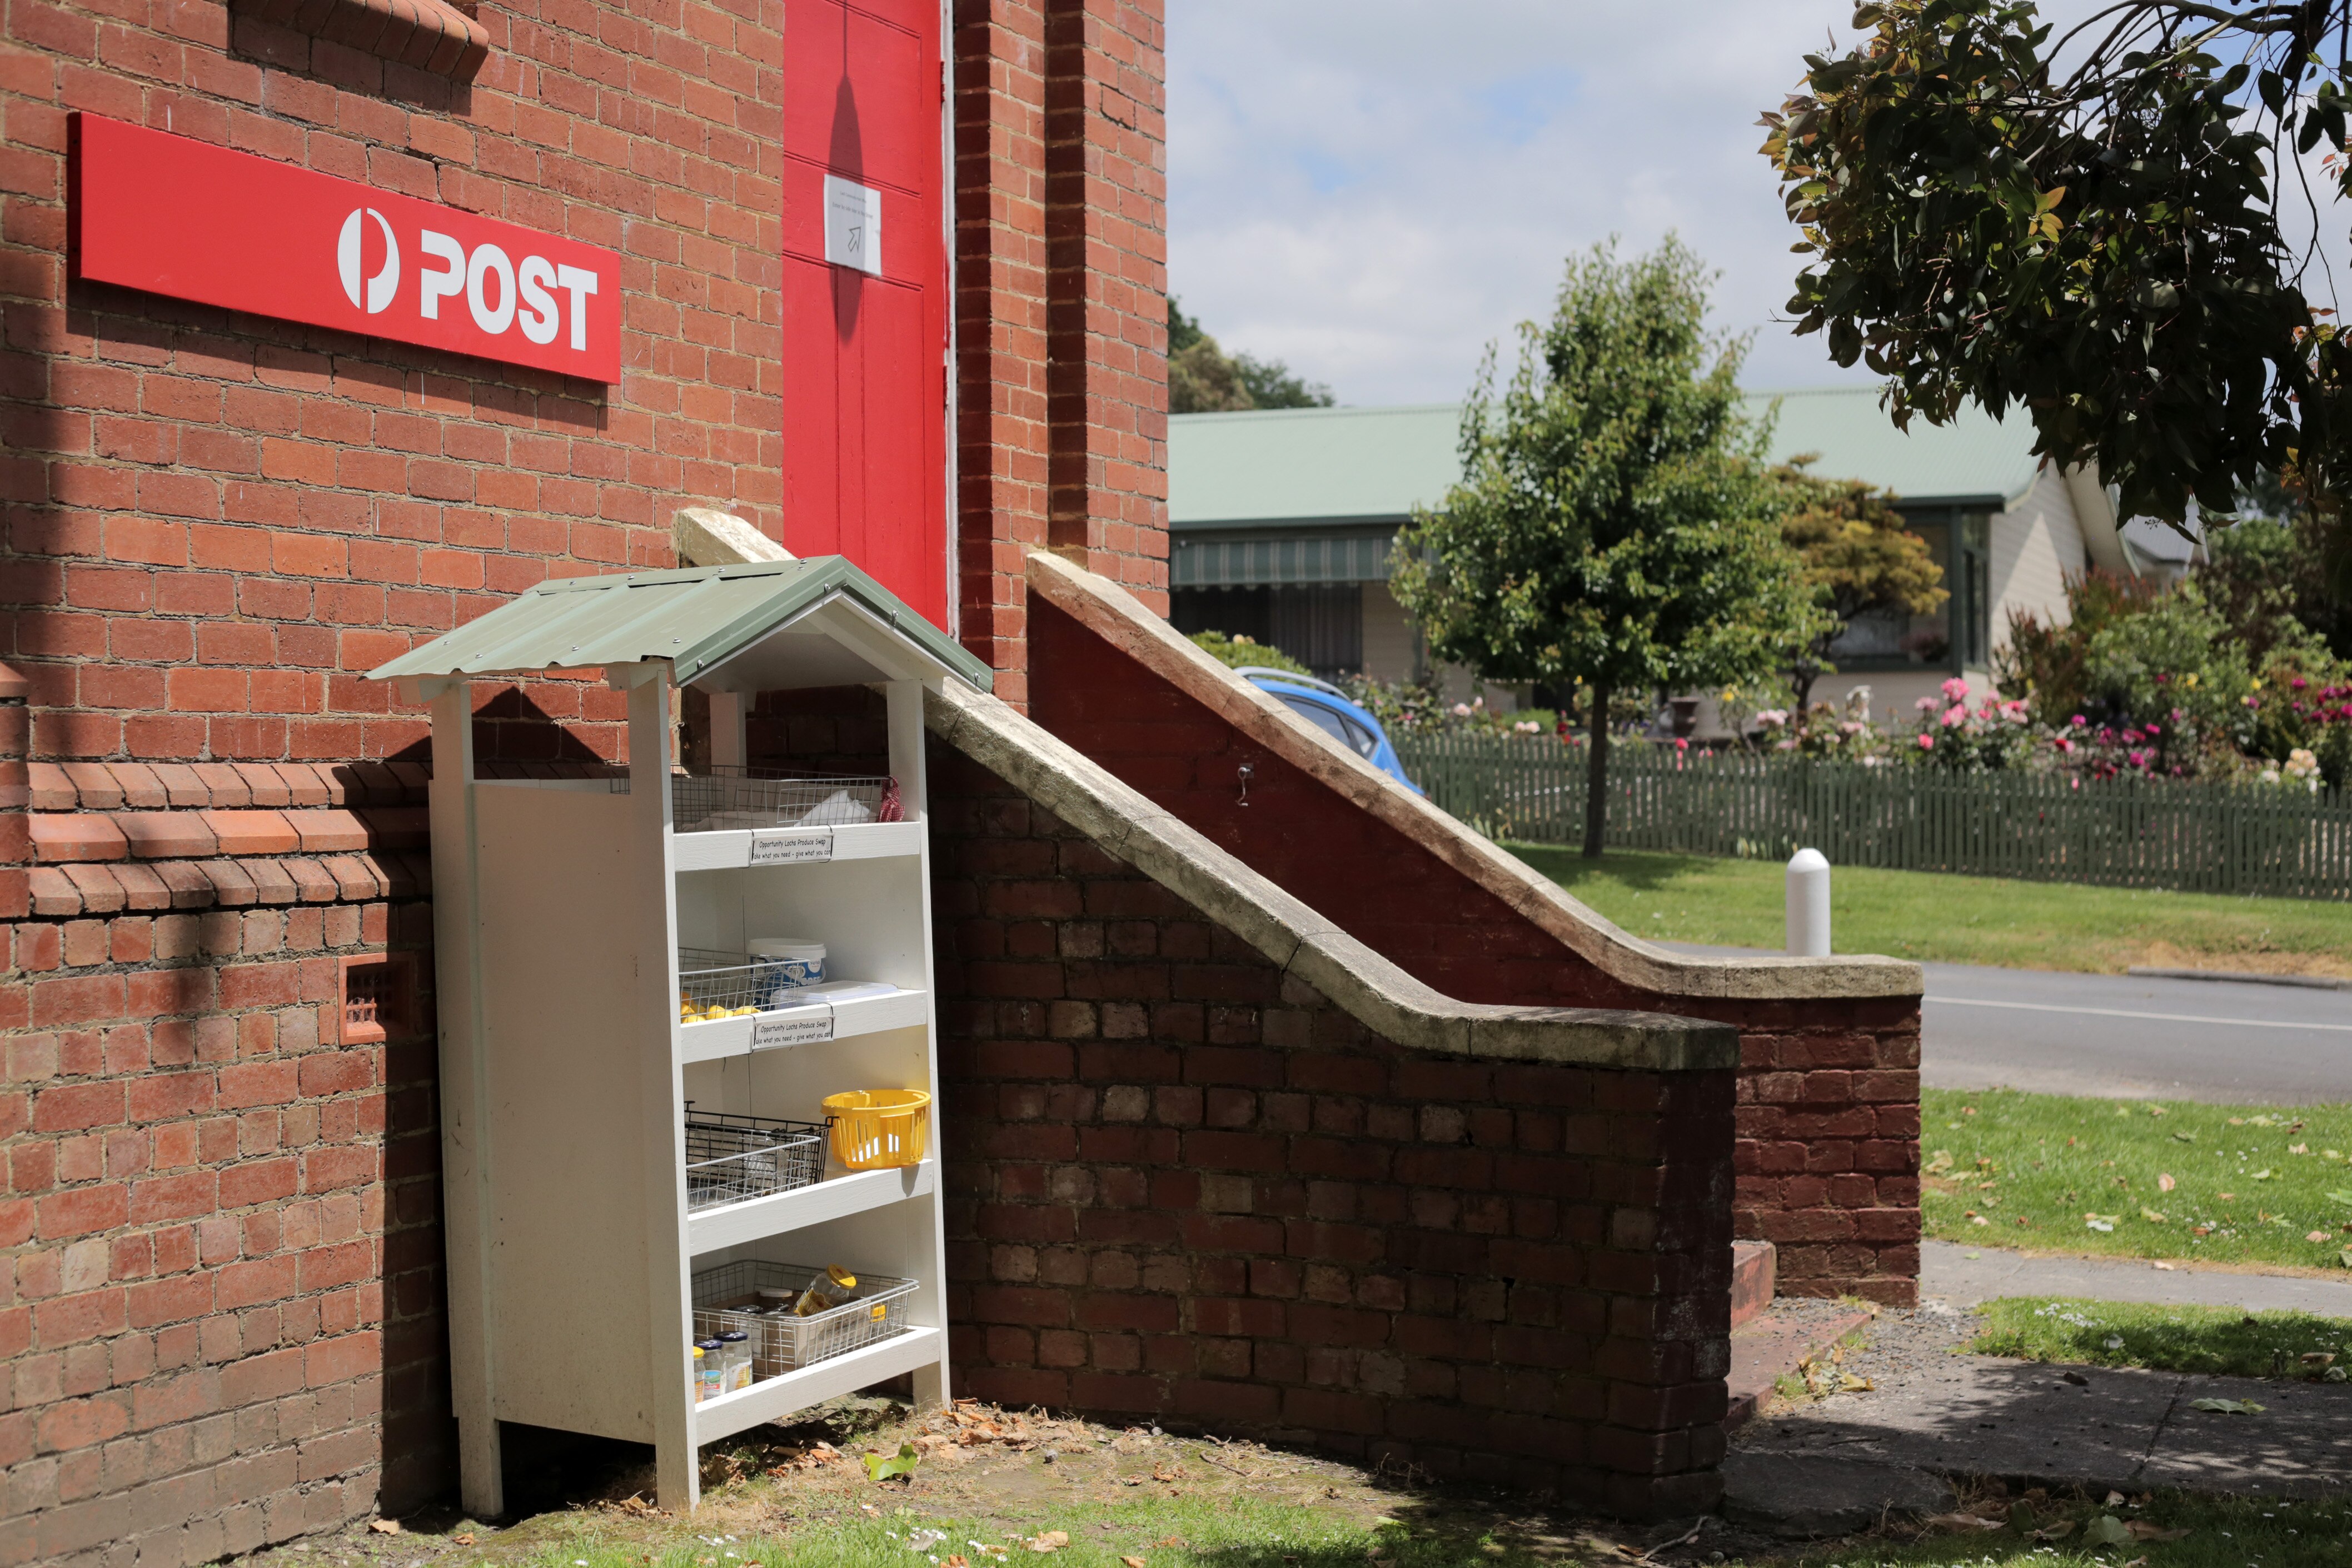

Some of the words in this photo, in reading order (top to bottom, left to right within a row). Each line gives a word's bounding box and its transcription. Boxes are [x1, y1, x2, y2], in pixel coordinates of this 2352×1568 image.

[421, 228, 597, 351] POST
[759, 840, 784, 850] Opportunity
[795, 850, 804, 858] give
[761, 1025, 785, 1034] Opportunity
